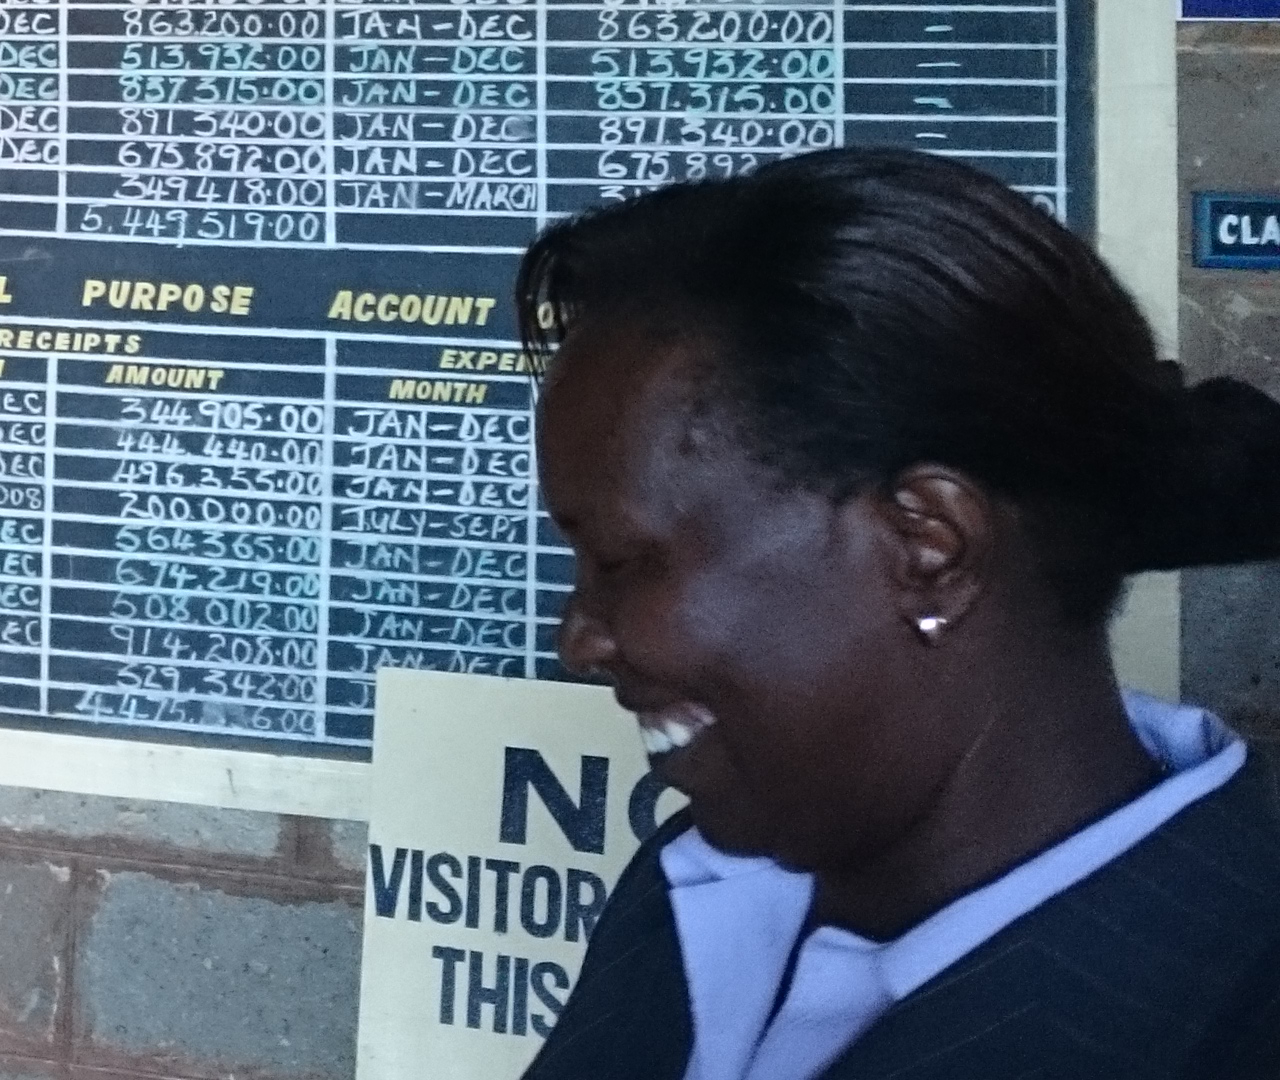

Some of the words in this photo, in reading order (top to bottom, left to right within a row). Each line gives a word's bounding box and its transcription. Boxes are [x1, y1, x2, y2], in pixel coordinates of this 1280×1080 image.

[83, 280, 254, 316] PURPOSE
[329, 290, 495, 326] ACCOUNT
[106, 364, 224, 389] AMOUNT
[389, 379, 487, 404] MONTH
[432, 944, 570, 1038] THIS
